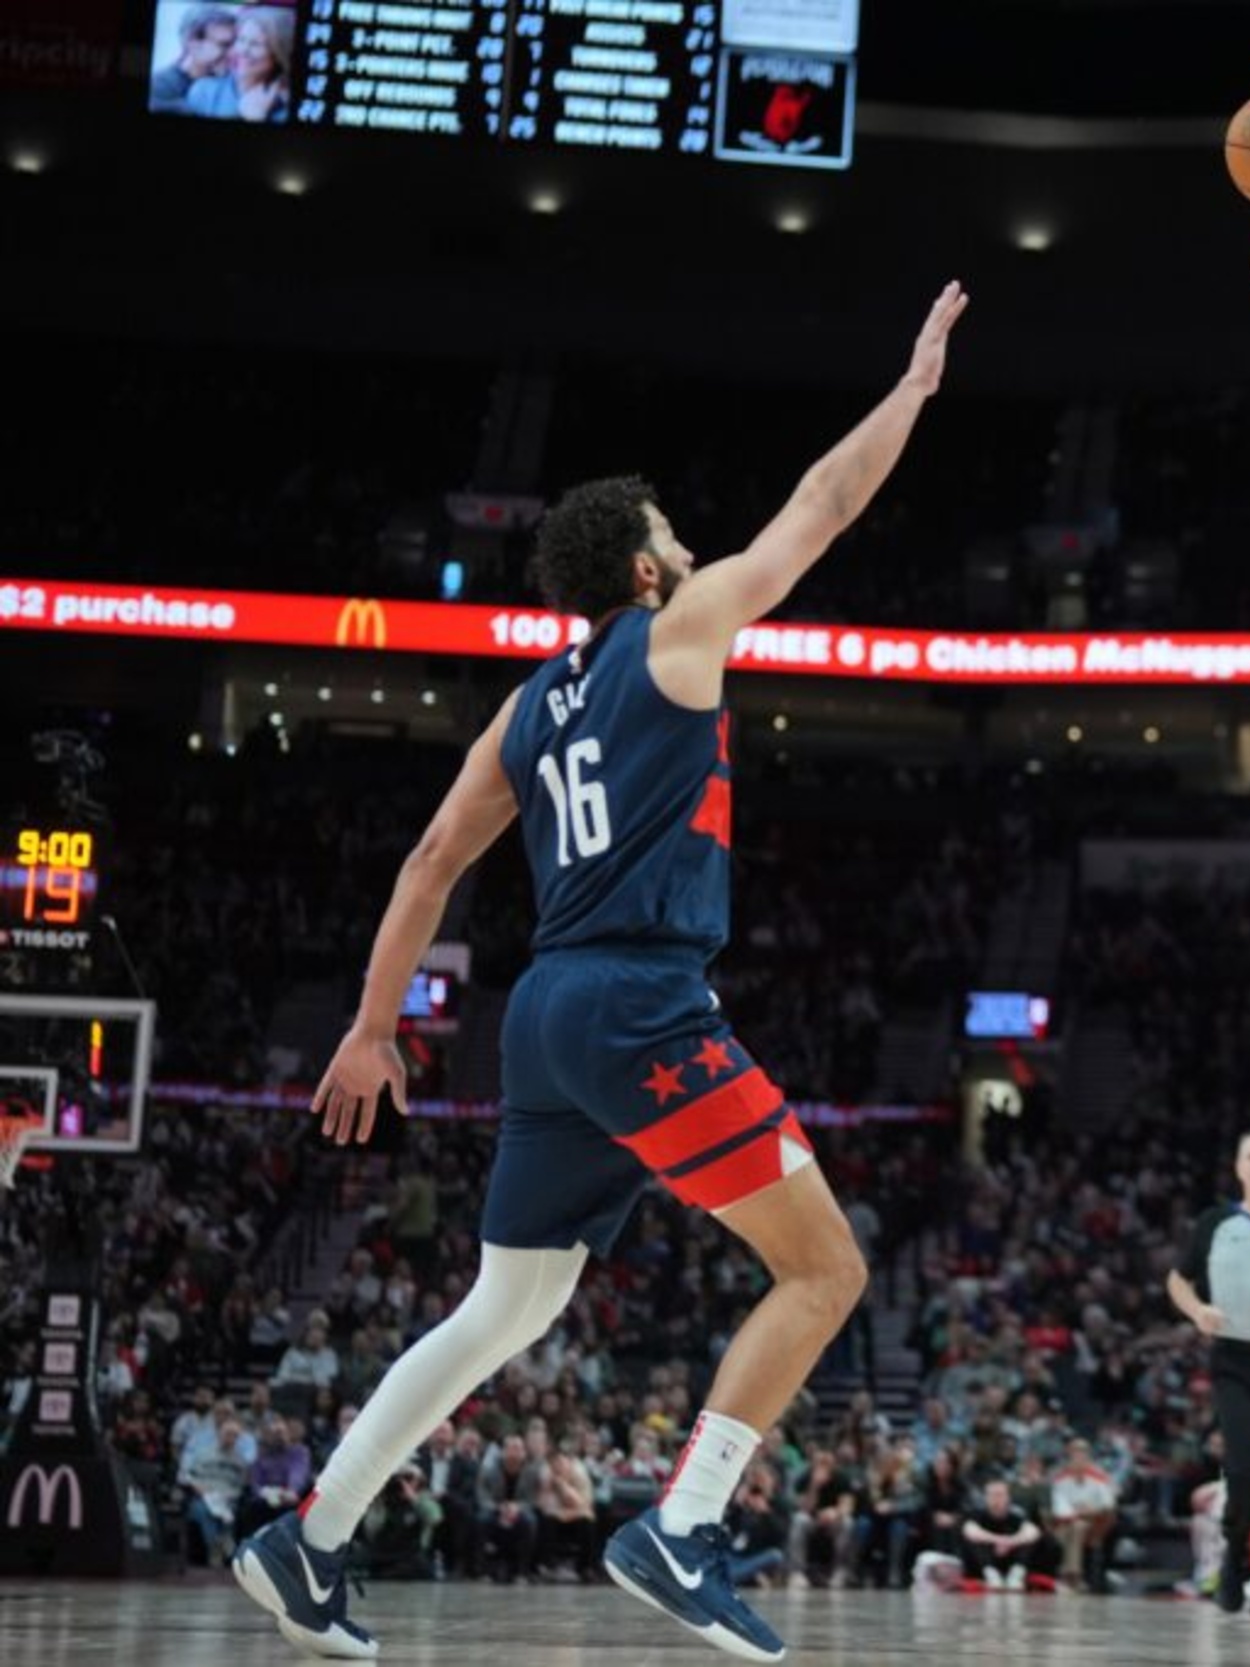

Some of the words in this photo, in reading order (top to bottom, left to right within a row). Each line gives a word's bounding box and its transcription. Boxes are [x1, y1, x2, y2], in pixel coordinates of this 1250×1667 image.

[53, 593, 236, 630] purchase
[490, 613, 561, 649] 100
[733, 626, 832, 664] FREE
[838, 632, 865, 668] 6
[925, 636, 1077, 673] Chicken
[537, 737, 611, 867] 16
[17, 829, 92, 868] 9:00
[24, 866, 81, 923] 19
